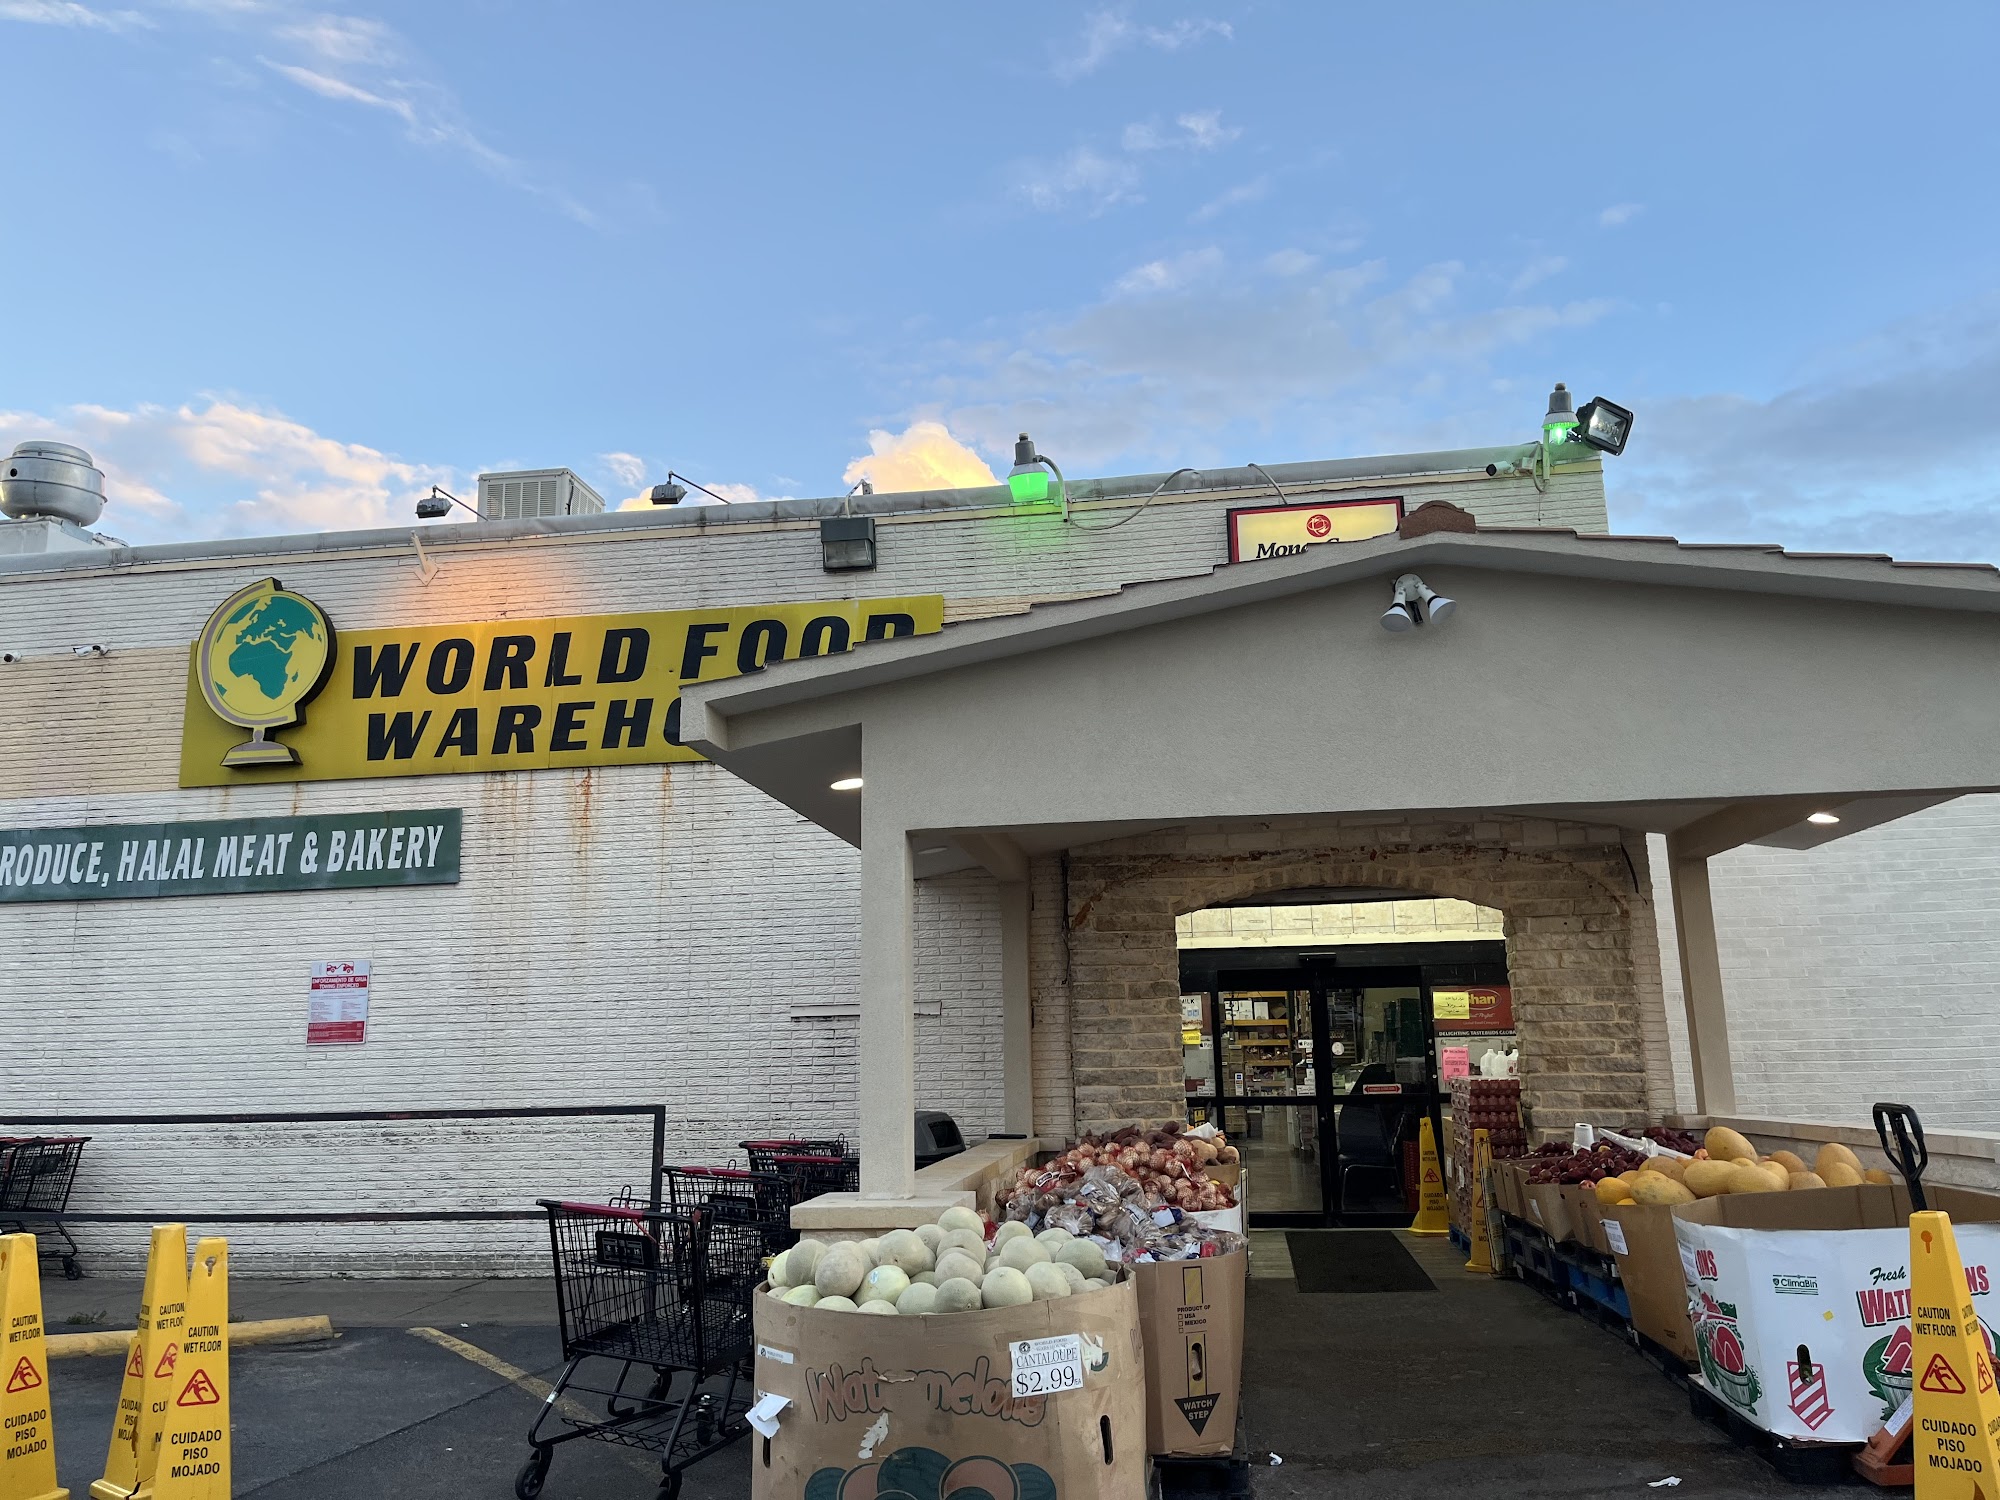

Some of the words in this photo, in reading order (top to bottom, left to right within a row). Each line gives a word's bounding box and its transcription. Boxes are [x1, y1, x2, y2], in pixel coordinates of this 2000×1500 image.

[353, 626, 651, 699] WORLD
[117, 837, 206, 883] HALAL
[213, 832, 294, 877] MEAT
[300, 831, 319, 874] &
[327, 825, 445, 872] BAKERY
[1469, 993, 1496, 1005] han
[1780, 1278, 1818, 1288] ClimaBin
[1869, 1265, 1907, 1286] Fresh
[160, 1301, 185, 1316] CAUTION
[1177, 1305, 1203, 1313] PRODUCT
[1917, 1306, 1951, 1320] CAUTION
[11, 1313, 38, 1328] CAUTION
[156, 1318, 169, 1330] WET
[1184, 1318, 1207, 1326] MEXICO
[9, 1331, 22, 1343] WET
[22, 1327, 41, 1341] FLOOR
[188, 1325, 220, 1338] CAUTION
[1915, 1322, 1932, 1336] WET
[1932, 1323, 1957, 1338] FLOOR
[183, 1341, 199, 1354] WET
[199, 1339, 222, 1353] FLOOR
[1016, 1347, 1078, 1368] CANTALOUPE
[1016, 1365, 1075, 1395] $2.99
[1183, 1399, 1213, 1411] WATCH
[4, 1409, 47, 1430] CUIDADO
[1188, 1410, 1209, 1421] STEP
[15, 1426, 37, 1442] PISO
[1921, 1418, 1976, 1436] CUIDADO
[171, 1429, 222, 1445] CUIDADO
[6, 1439, 47, 1460] MOJADO
[1937, 1438, 1965, 1453] PISO
[182, 1446, 208, 1461] PISO
[171, 1462, 220, 1478] MOJADO
[1928, 1454, 1982, 1473] MOJADO
